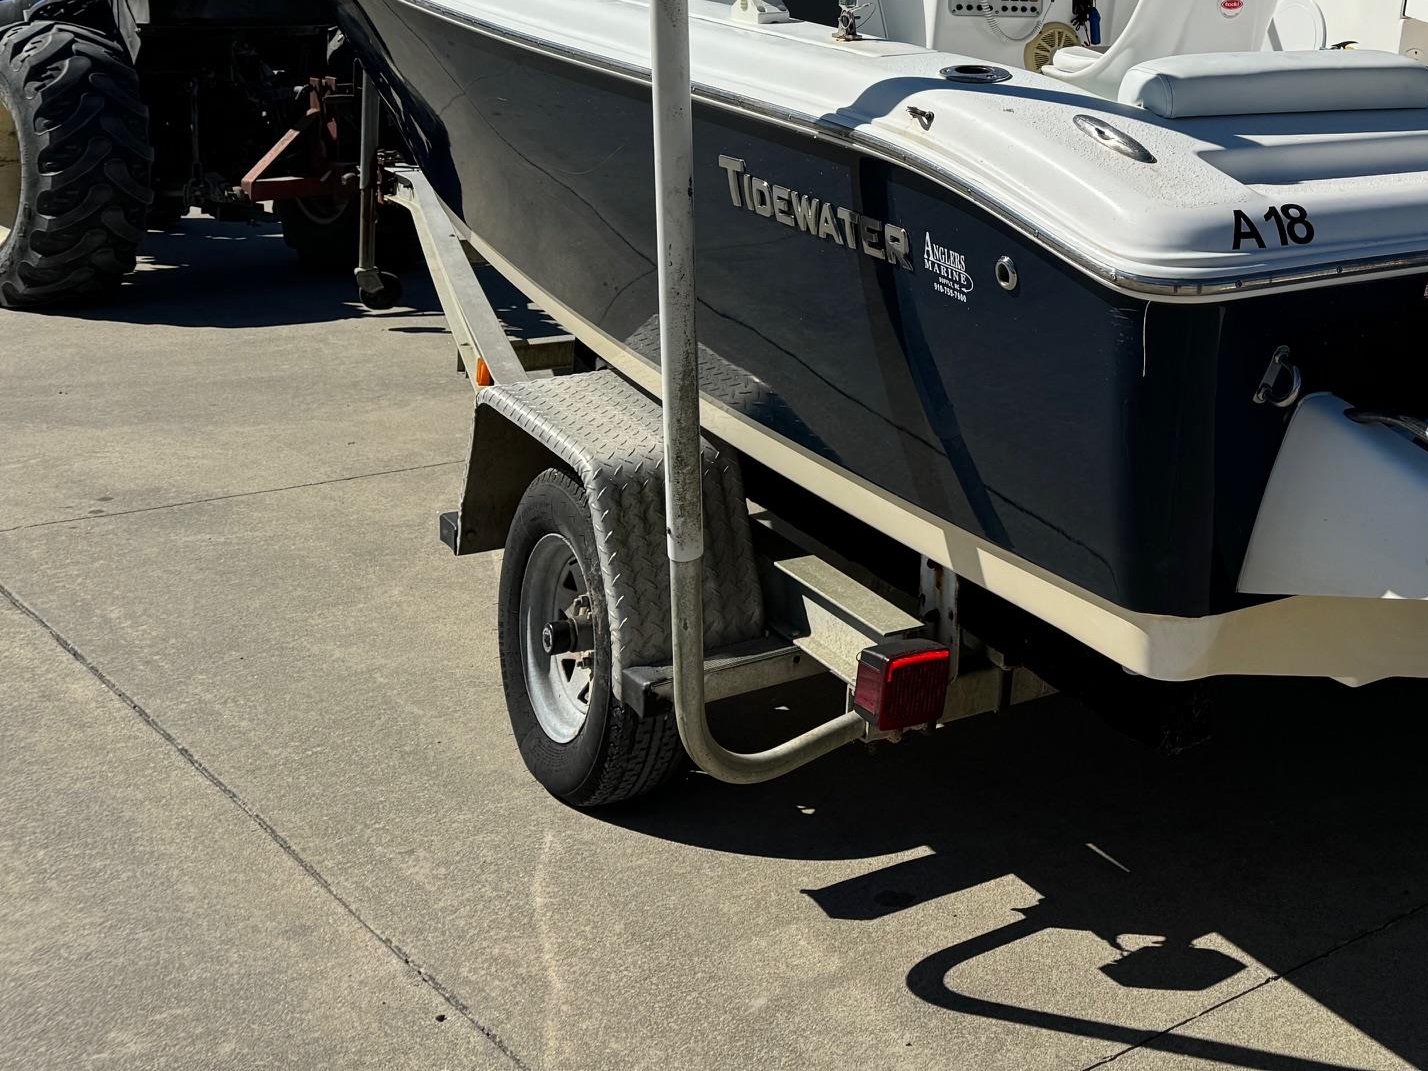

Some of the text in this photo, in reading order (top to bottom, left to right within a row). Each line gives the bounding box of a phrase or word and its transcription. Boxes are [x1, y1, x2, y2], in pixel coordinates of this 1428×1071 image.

[718, 154, 914, 272] TIDEWATER
[923, 231, 966, 272] ANGLERS
[924, 258, 967, 285] MARINE
